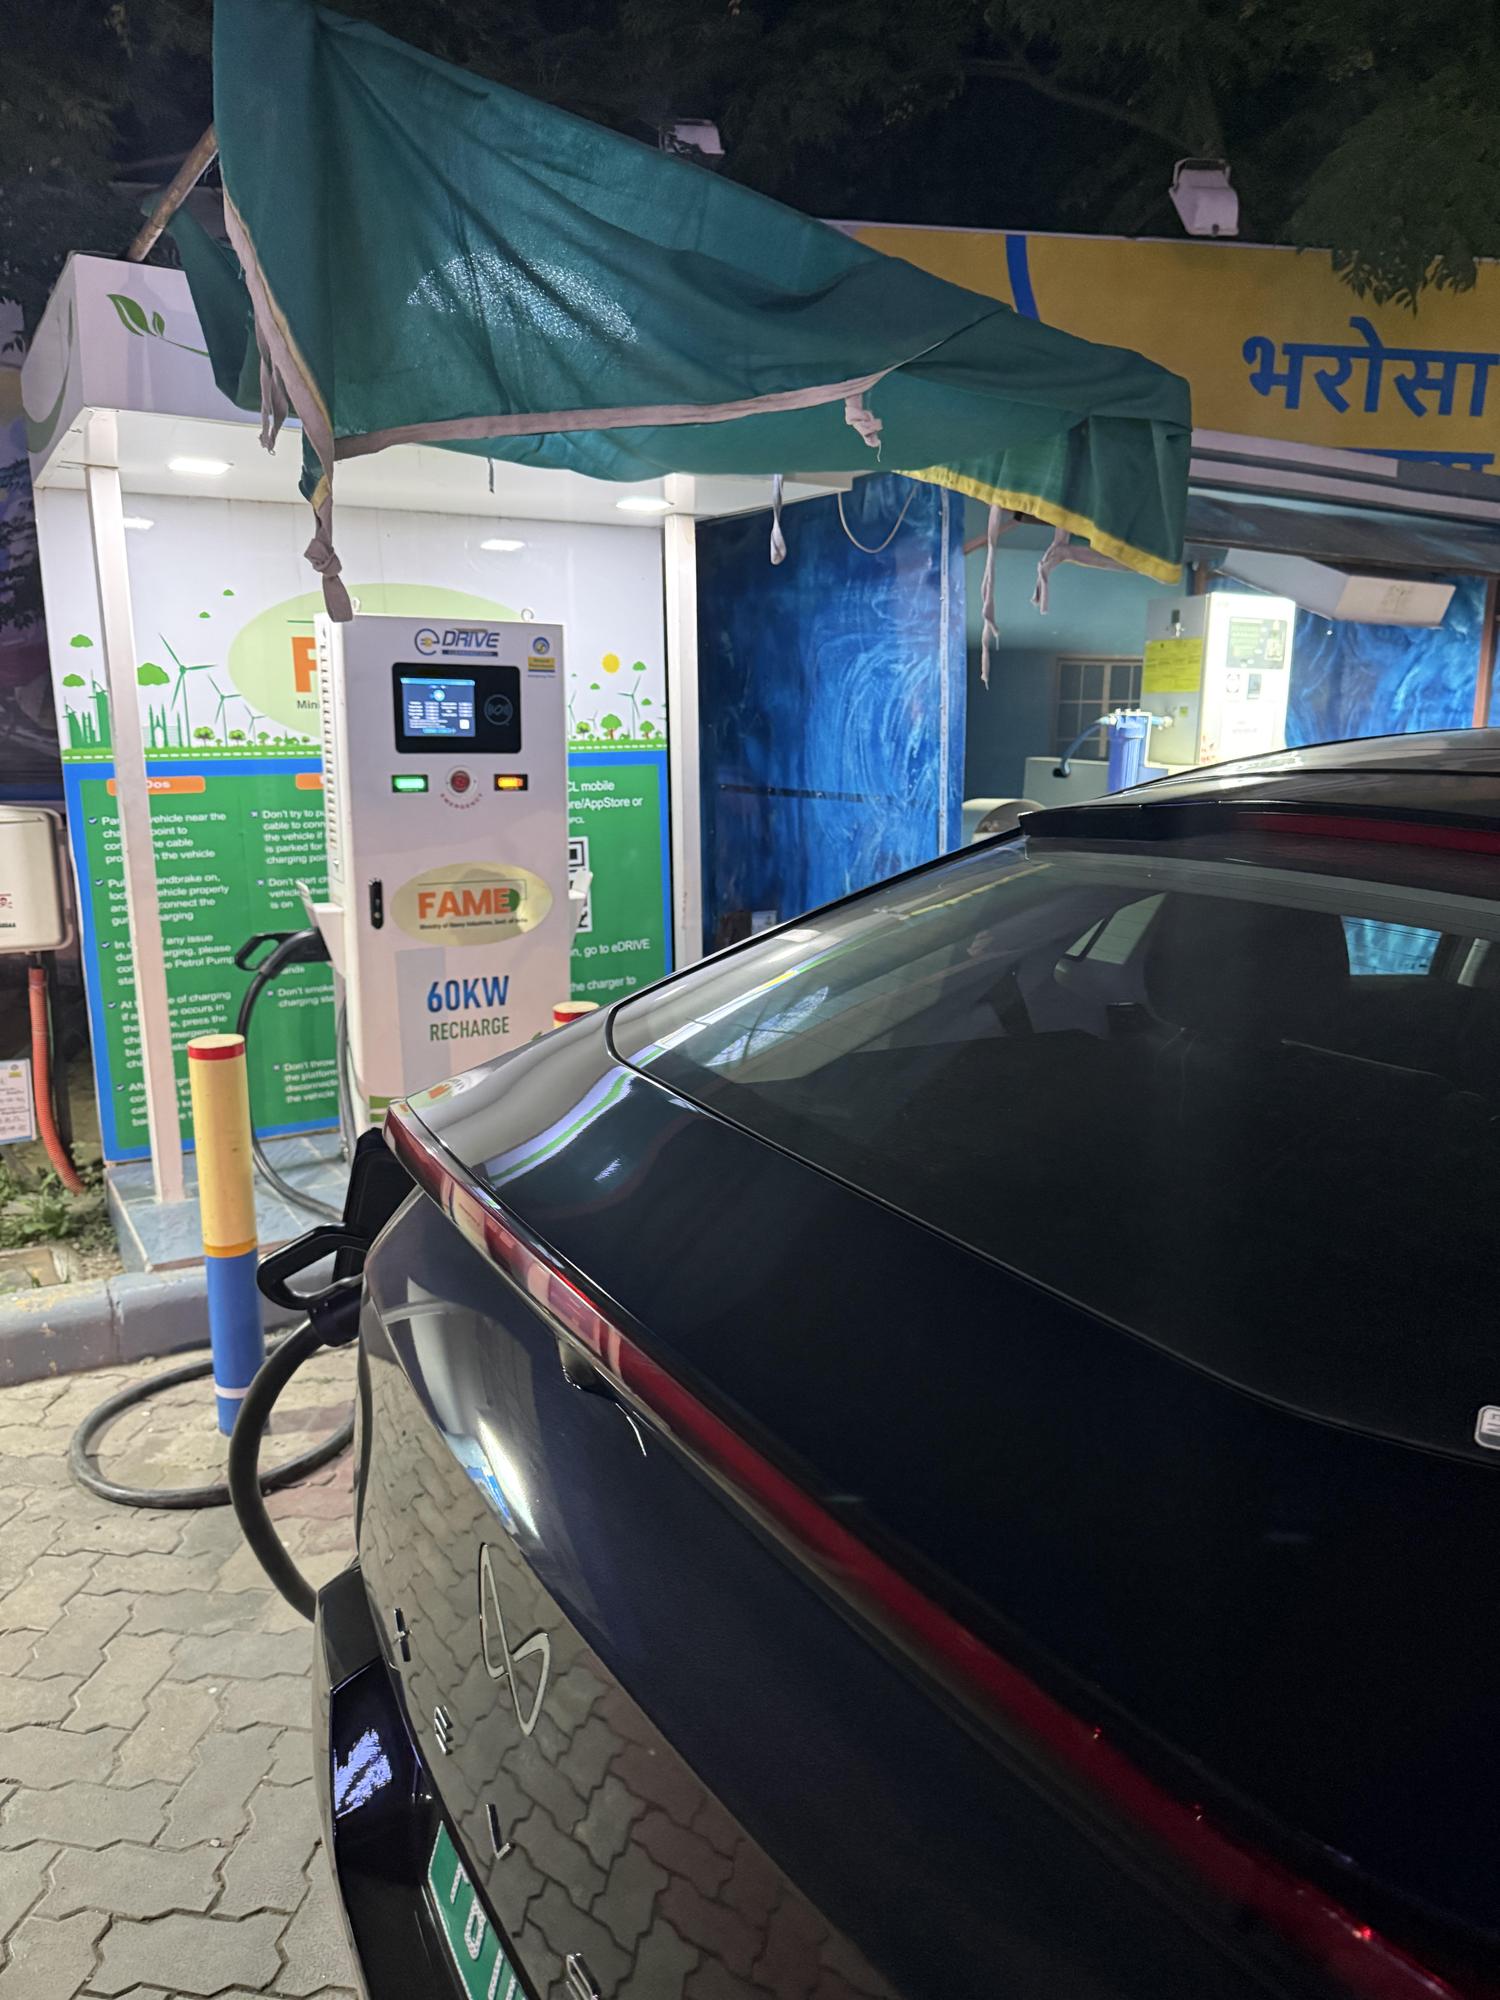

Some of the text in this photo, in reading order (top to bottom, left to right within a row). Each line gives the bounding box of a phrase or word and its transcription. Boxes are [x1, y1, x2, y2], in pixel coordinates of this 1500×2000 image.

[1242, 316, 1500, 418] भरोसा
[580, 780, 615, 792] mobile
[631, 797, 643, 807] or
[418, 887, 512, 919] FAME
[584, 946, 597, 959] go
[598, 945, 609, 955] to
[611, 938, 651, 954] eDRIVE
[427, 975, 510, 1013] 60KW
[587, 976, 625, 992] charger
[626, 975, 637, 986] to
[430, 1016, 510, 1042] RECHARGE
